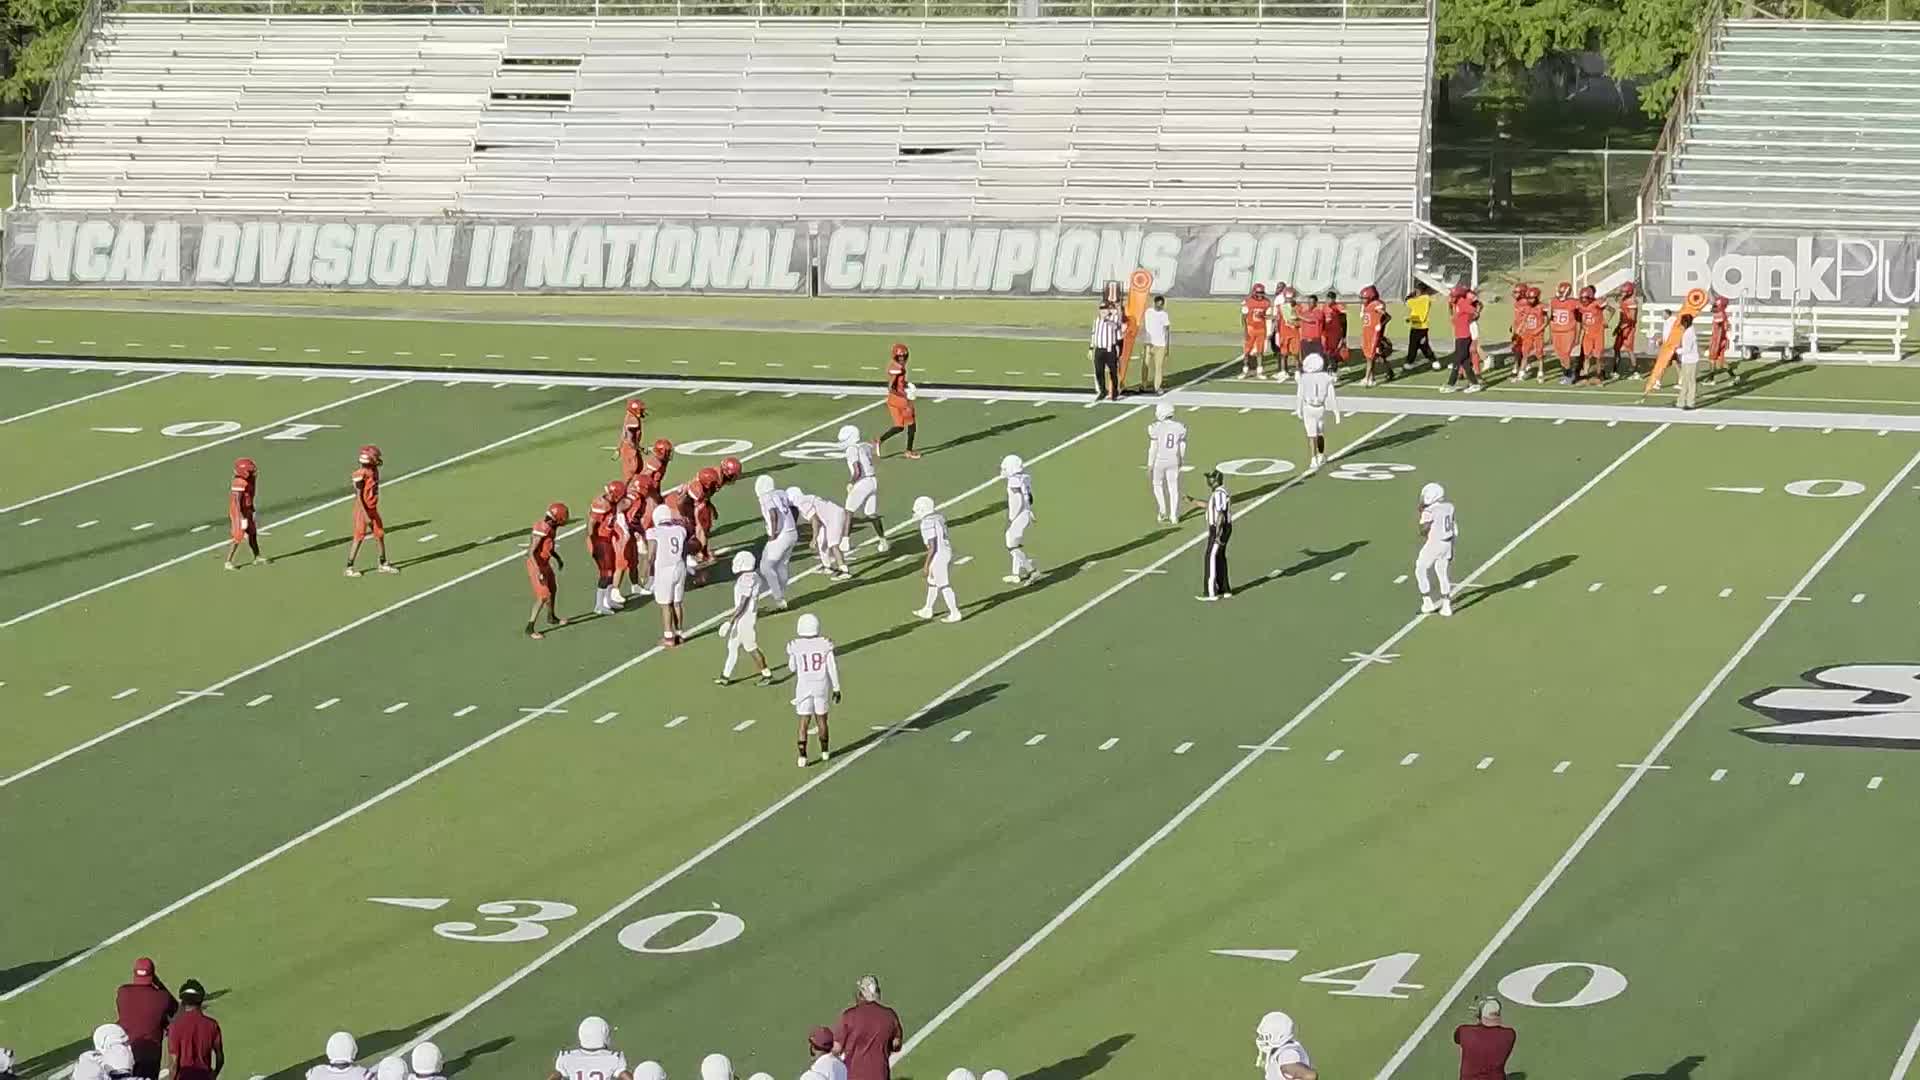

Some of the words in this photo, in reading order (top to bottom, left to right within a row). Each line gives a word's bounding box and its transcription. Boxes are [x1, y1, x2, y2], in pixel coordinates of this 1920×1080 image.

[30, 219, 182, 282] NCAA
[195, 222, 455, 287] DIVISION
[465, 224, 515, 288] II
[525, 224, 801, 290] NATIONAL
[823, 224, 1182, 295] CHAMPIONS
[1210, 230, 1381, 295] 2000
[1165, 432, 1175, 450] 8
[670, 536, 680, 555] 9
[801, 651, 824, 673] 18
